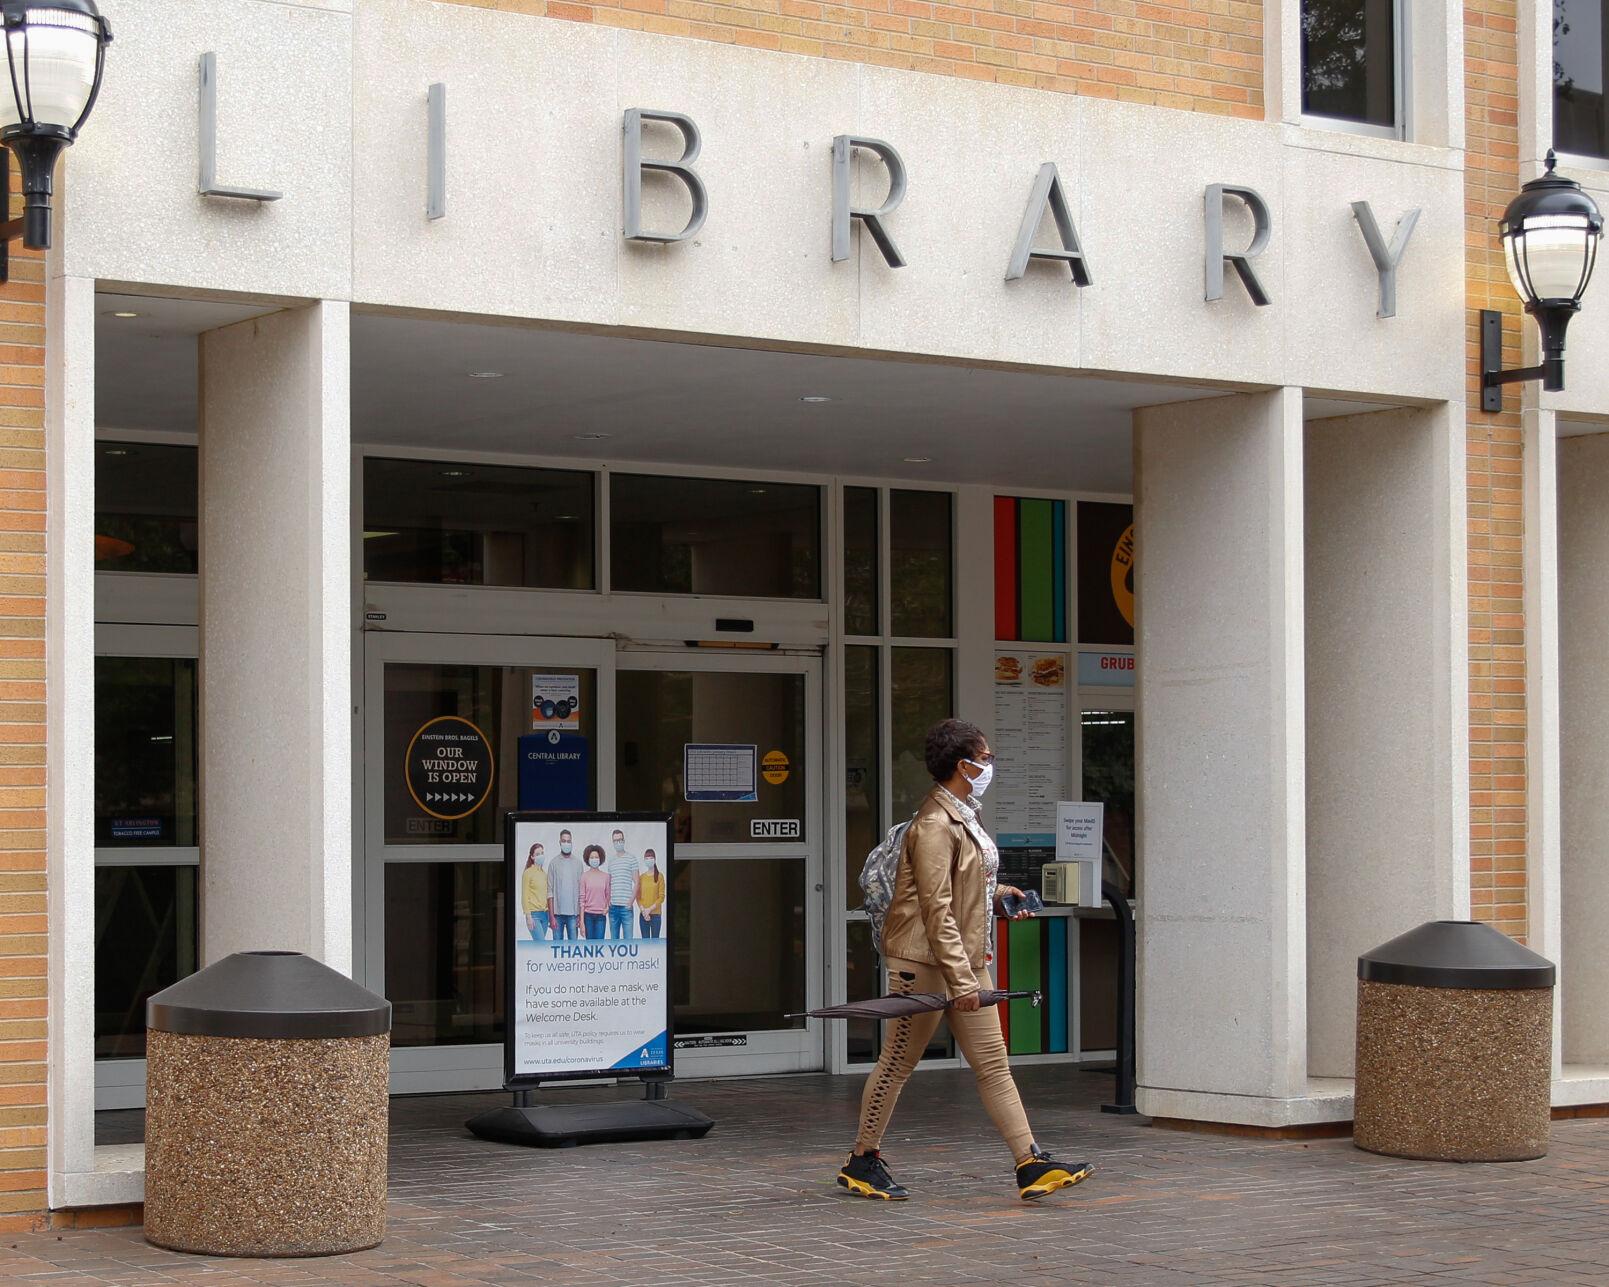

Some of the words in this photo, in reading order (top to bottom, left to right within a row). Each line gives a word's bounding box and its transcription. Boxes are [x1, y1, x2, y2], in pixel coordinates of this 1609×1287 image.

[198, 51, 1421, 318] LIBRARY
[1100, 656, 1134, 670] GRUB
[437, 747, 463, 758] OUR
[422, 760, 478, 770] WINDOW
[428, 772, 439, 783] IS
[442, 772, 477, 783] OPEN
[408, 820, 449, 832] ENTER
[753, 822, 798, 835] ENTER
[551, 945, 604, 958] THANK
[610, 944, 638, 957] YOU
[526, 960, 543, 972] for
[546, 960, 596, 974] wearing
[598, 960, 623, 974] your
[627, 958, 660, 970] mask!
[526, 985, 532, 994] If
[532, 986, 551, 996] you
[554, 985, 566, 994] do
[569, 985, 585, 994] not
[588, 984, 608, 993] have
[618, 982, 644, 993] mask,
[646, 983, 658, 991] we
[526, 1000, 548, 1009] have
[551, 1000, 577, 1008] some
[579, 997, 618, 1007] available
[621, 998, 630, 1006] at
[632, 996, 646, 1005] the
[526, 1012, 570, 1023] Welcome
[573, 1011, 598, 1022] Desk.
[582, 1030, 598, 1038] policy
[524, 1056, 604, 1065] www.uta.edu/coronavirus
